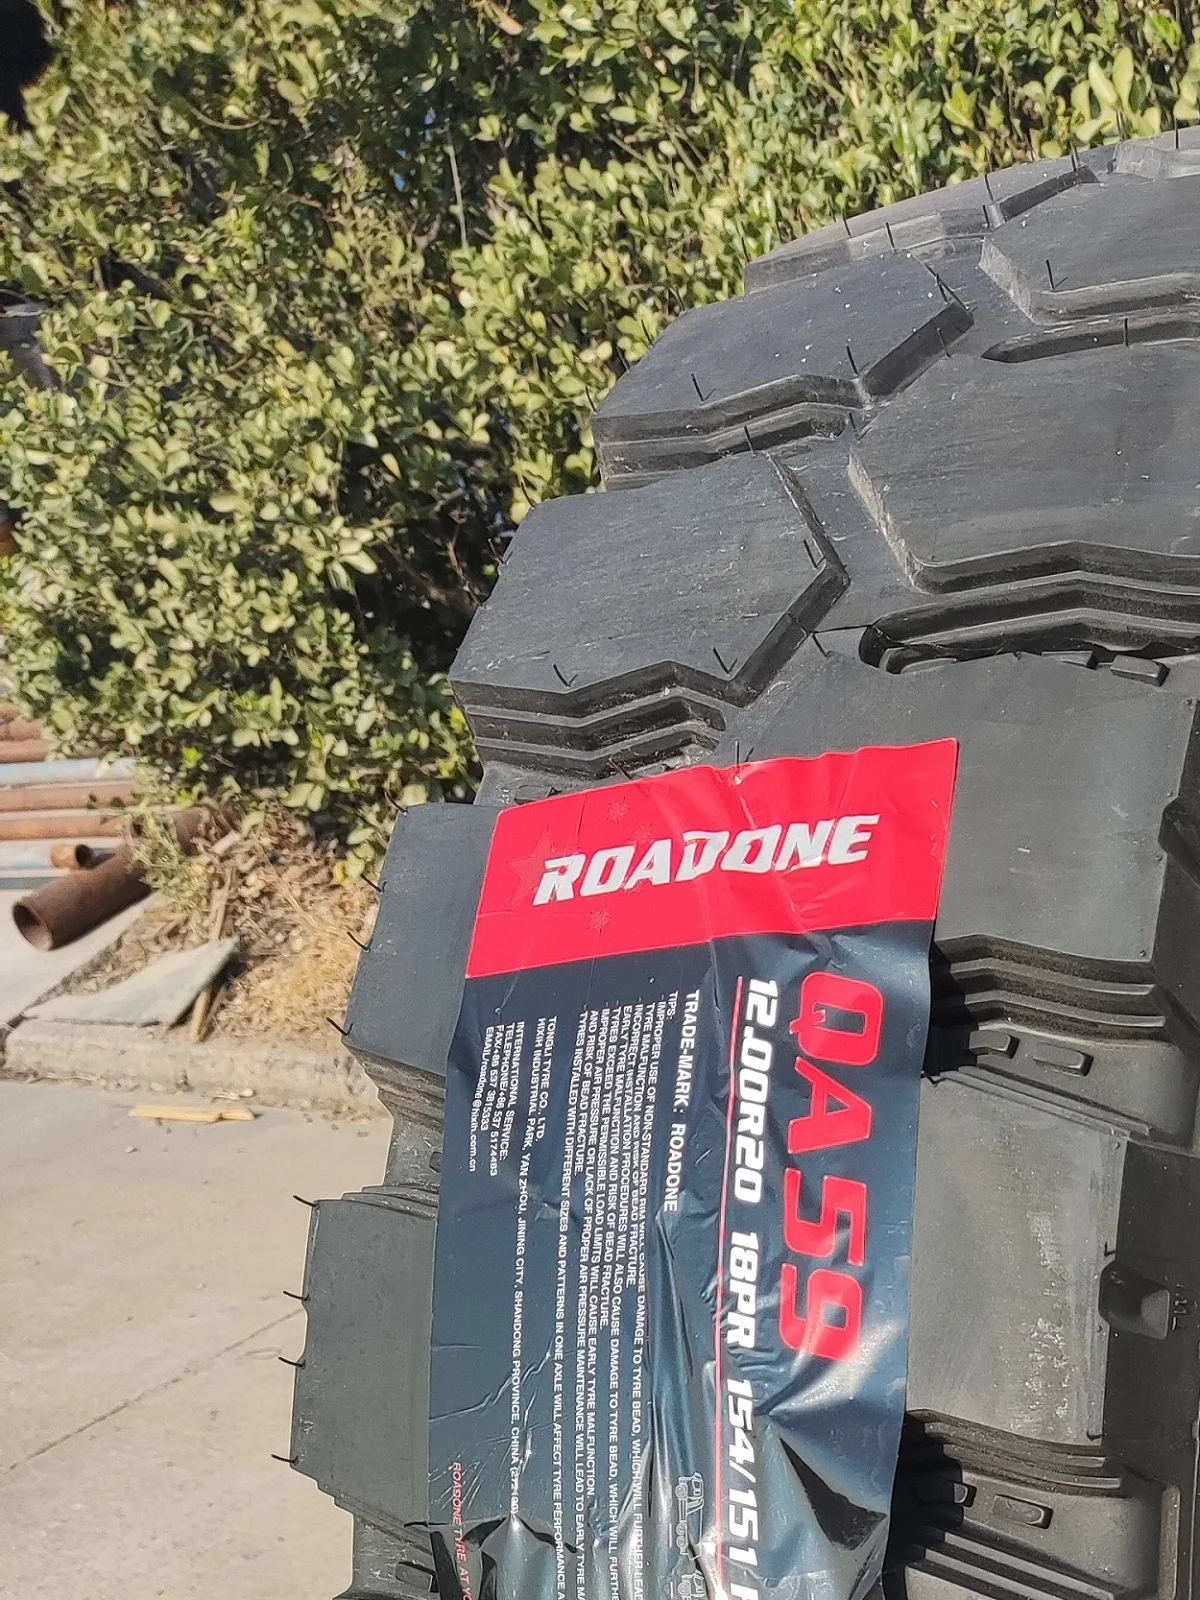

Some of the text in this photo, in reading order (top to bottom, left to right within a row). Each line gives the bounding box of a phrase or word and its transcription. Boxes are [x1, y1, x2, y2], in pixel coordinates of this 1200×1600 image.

[532, 814, 880, 906] ROADONE
[643, 1002, 655, 1031] TYRE
[666, 990, 678, 1019] TIPS:
[535, 1018, 546, 1046] HIXIH
[543, 1016, 557, 1056] TONGLI
[576, 1010, 588, 1046] TYRES
[596, 1008, 610, 1064] IMPROPER
[627, 1004, 643, 1067] INCORRECT
[651, 1001, 667, 1058] IMPROPER
[480, 1025, 504, 1130] FAX/+86 537 3815333
[496, 1023, 515, 1108] TELEPHONE/+86
[528, 1049, 542, 1115] INDUSTRIAL
[541, 1058, 551, 1089] TYRE
[568, 1048, 583, 1104] INSTALLED
[593, 1066, 603, 1084] AIR
[633, 1034, 650, 1110] MALFUNCTION
[648, 1061, 659, 1084] USE
[499, 1021, 525, 1160] INTERNATIONAL SERVICE:
[574, 1010, 598, 1176] AND RISK OF BEAD FRACTURE.
[646, 1087, 657, 1102] OF
[733, 978, 779, 1204] 12.00R20
[492, 1110, 503, 1128] 537
[566, 1106, 577, 1134] WITH
[588, 1087, 601, 1145] PRESSURE
[623, 1069, 635, 1149] INSTALLATION
[633, 1114, 641, 1137] AND
[523, 1118, 536, 1150] PARK,
[535, 1117, 546, 1141] LTD.
[520, 1153, 530, 1175] YAN
[561, 1137, 574, 1197] DIFFERENT
[586, 1148, 596, 1164] OR
[599, 1005, 632, 1330] EARLY TYRE MALFUNCTION AND RISK OF BEAD FRACTURE.
[639, 1104, 654, 1195] NON-STANDARD
[663, 1123, 686, 1211] ROADONE
[778, 971, 885, 1360] QA59
[518, 1178, 528, 1214] ZHOU,
[584, 1166, 595, 1195] LACK
[619, 1152, 631, 1231] PROCEDURES
[631, 1170, 639, 1187] OF
[559, 1200, 570, 1231] SIZES
[584, 1198, 593, 1214] OF
[631, 1189, 639, 1221] BEAD
[516, 1217, 526, 1254] JINING
[558, 1234, 567, 1257] AND
[580, 1216, 592, 1261] PROPER
[587, 1006, 621, 1498] TYRES EXCEED THE PERMISSIBLE LOAD LIMITS WILL CAUSE EARLY TYRE MALFUNCTION.
[615, 1234, 626, 1261] WILL
[514, 1257, 524, 1287] CITY,
[556, 1260, 567, 1319] PATTERNS
[579, 1264, 588, 1283] AIR
[613, 1263, 624, 1293] ALSO
[637, 1252, 646, 1292] CAUSE
[726, 1231, 760, 1349] 18PR
[513, 1290, 522, 1357] SHANDONG
[555, 1321, 564, 1332] IN
[577, 1285, 587, 1347] PRESSURE
[610, 1296, 621, 1335] CAUSE
[634, 1295, 646, 1345] DAMAGE
[555, 1335, 563, 1359] ONE
[610, 1339, 619, 1389] DAMAGE
[633, 1349, 642, 1364] TO
[511, 1360, 520, 1424] PROVINCE,
[554, 1362, 563, 1391] AXLE
[576, 1350, 585, 1431] MAINTENANCE
[633, 1367, 642, 1397] TYRE
[553, 1394, 562, 1421] WILL
[609, 1392, 618, 1408] TO
[609, 1410, 618, 1442] TYRE
[632, 1401, 641, 1436] BEAD,
[511, 1427, 519, 1463] CHINA
[553, 1422, 562, 1466] AFFECT
[575, 1433, 584, 1460] WILL
[632, 1439, 641, 1479] WHICH
[575, 1463, 584, 1492] LEAD
[609, 1445, 618, 1481] BEAD,
[553, 1468, 562, 1499] TYRE
[632, 1481, 642, 1509] WILL
[575, 1494, 584, 1511] TO
[609, 1483, 618, 1523] WHICH
[453, 1462, 461, 1524] ROADONE
[457, 1566, 470, 1584] AT
[575, 1514, 585, 1551] EARLY
[608, 1525, 618, 1553] WILL
[632, 1513, 643, 1568] FURTHER
[553, 1502, 565, 1589] PERFORMANCE
[577, 1554, 585, 1584] TYRE
